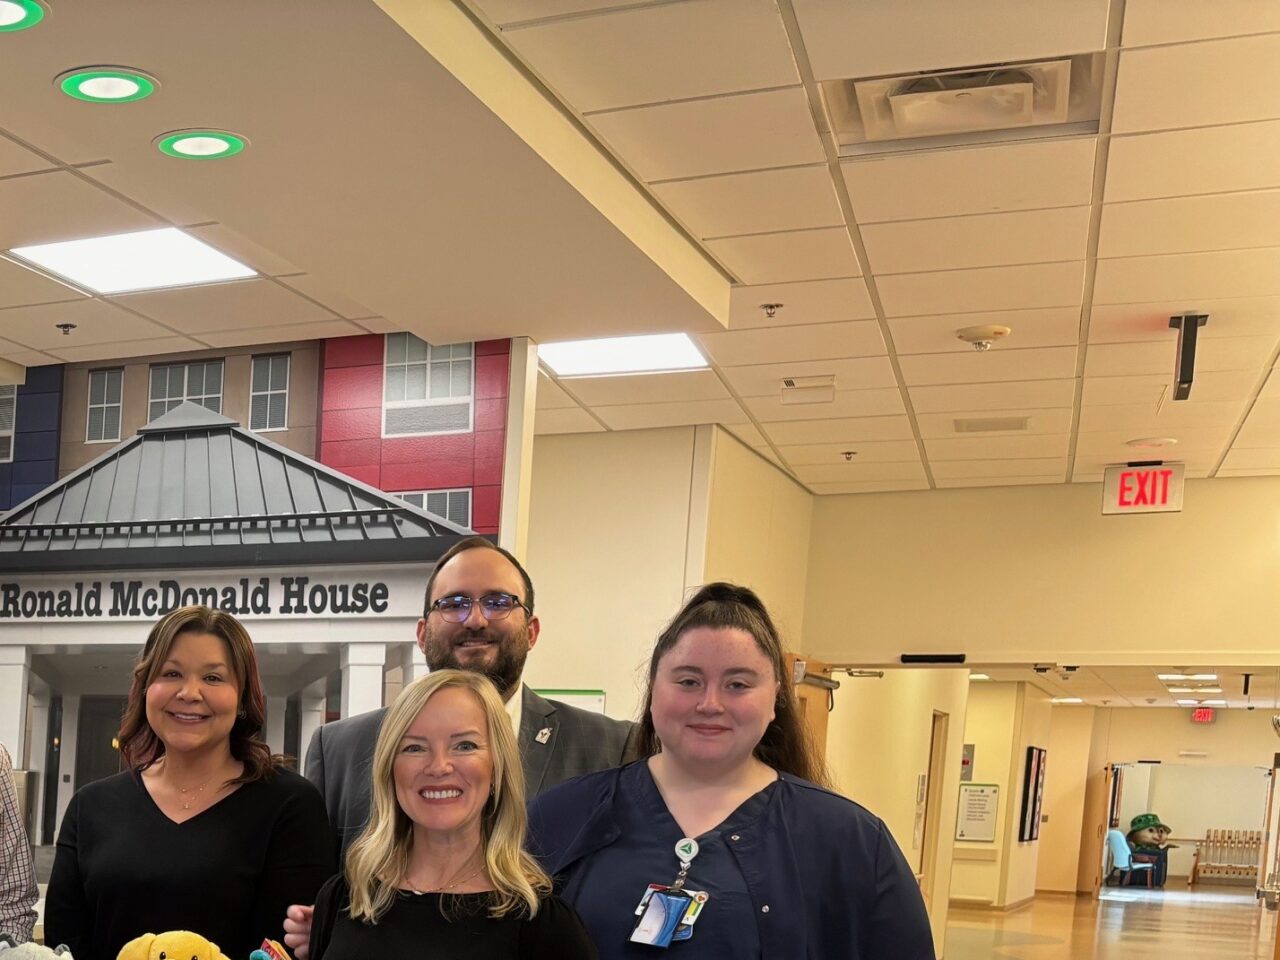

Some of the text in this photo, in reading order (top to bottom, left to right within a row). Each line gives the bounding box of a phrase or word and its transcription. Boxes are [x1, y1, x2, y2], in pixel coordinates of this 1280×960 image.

[1118, 469, 1173, 507] EXIT
[0, 576, 389, 618] Ronald McDonald House
